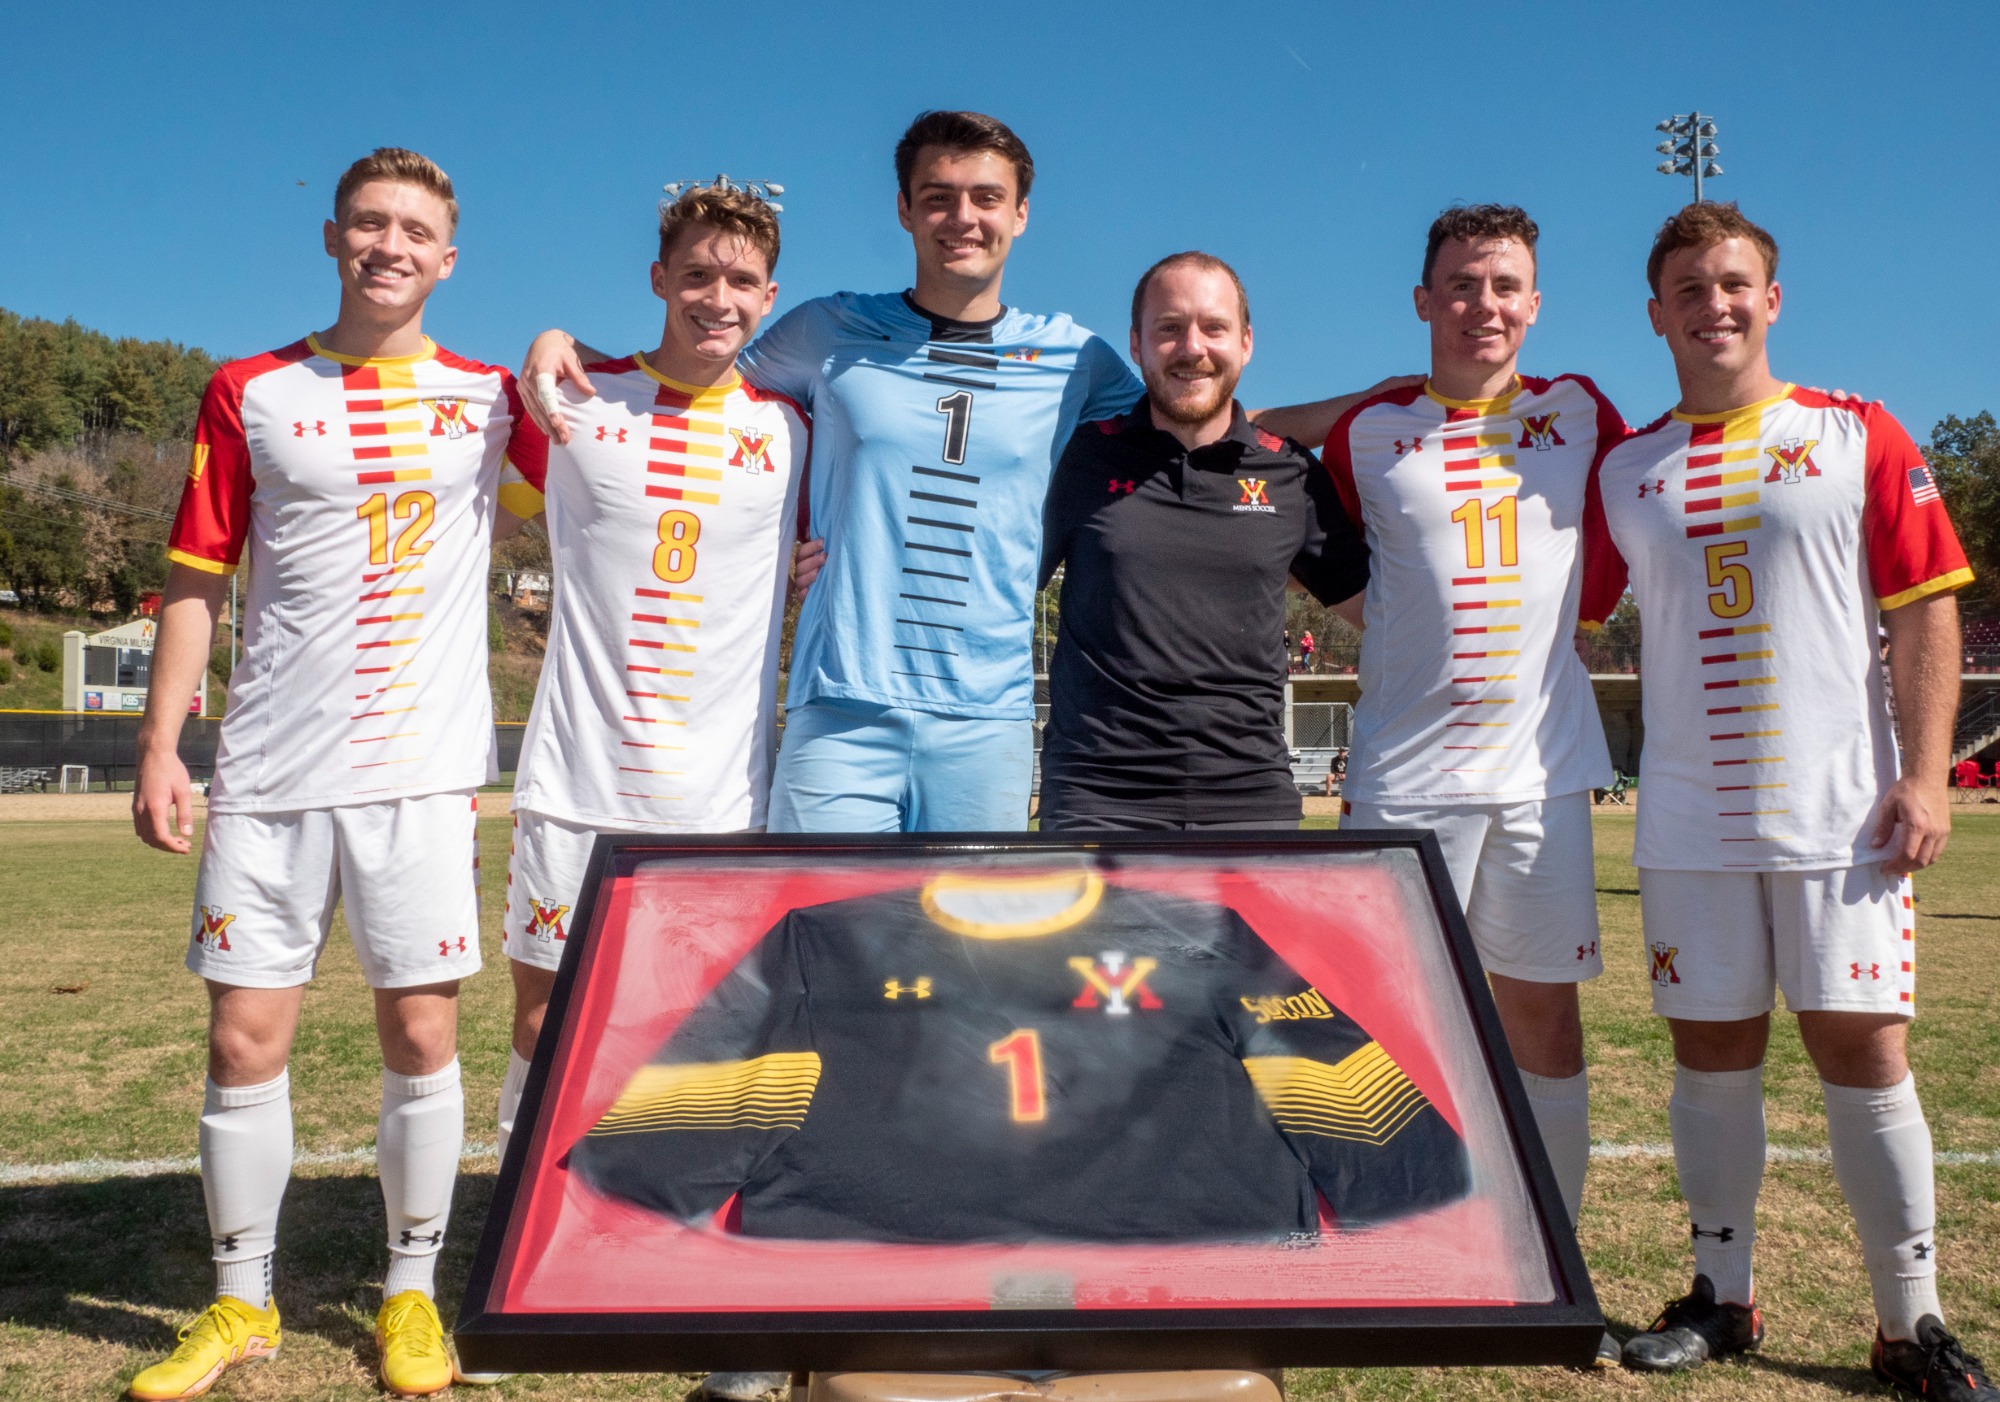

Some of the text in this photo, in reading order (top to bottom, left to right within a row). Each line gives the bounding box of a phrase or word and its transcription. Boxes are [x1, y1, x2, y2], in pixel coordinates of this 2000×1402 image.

[936, 390, 973, 465] 1
[357, 490, 437, 565] 12
[652, 509, 701, 584] 8
[1451, 495, 1518, 569] 11
[1704, 540, 1754, 619] 5
[99, 636, 155, 648] VIRGINIA MILITAR
[122, 694, 138, 706] KBS
[990, 1028, 1045, 1121] 1
